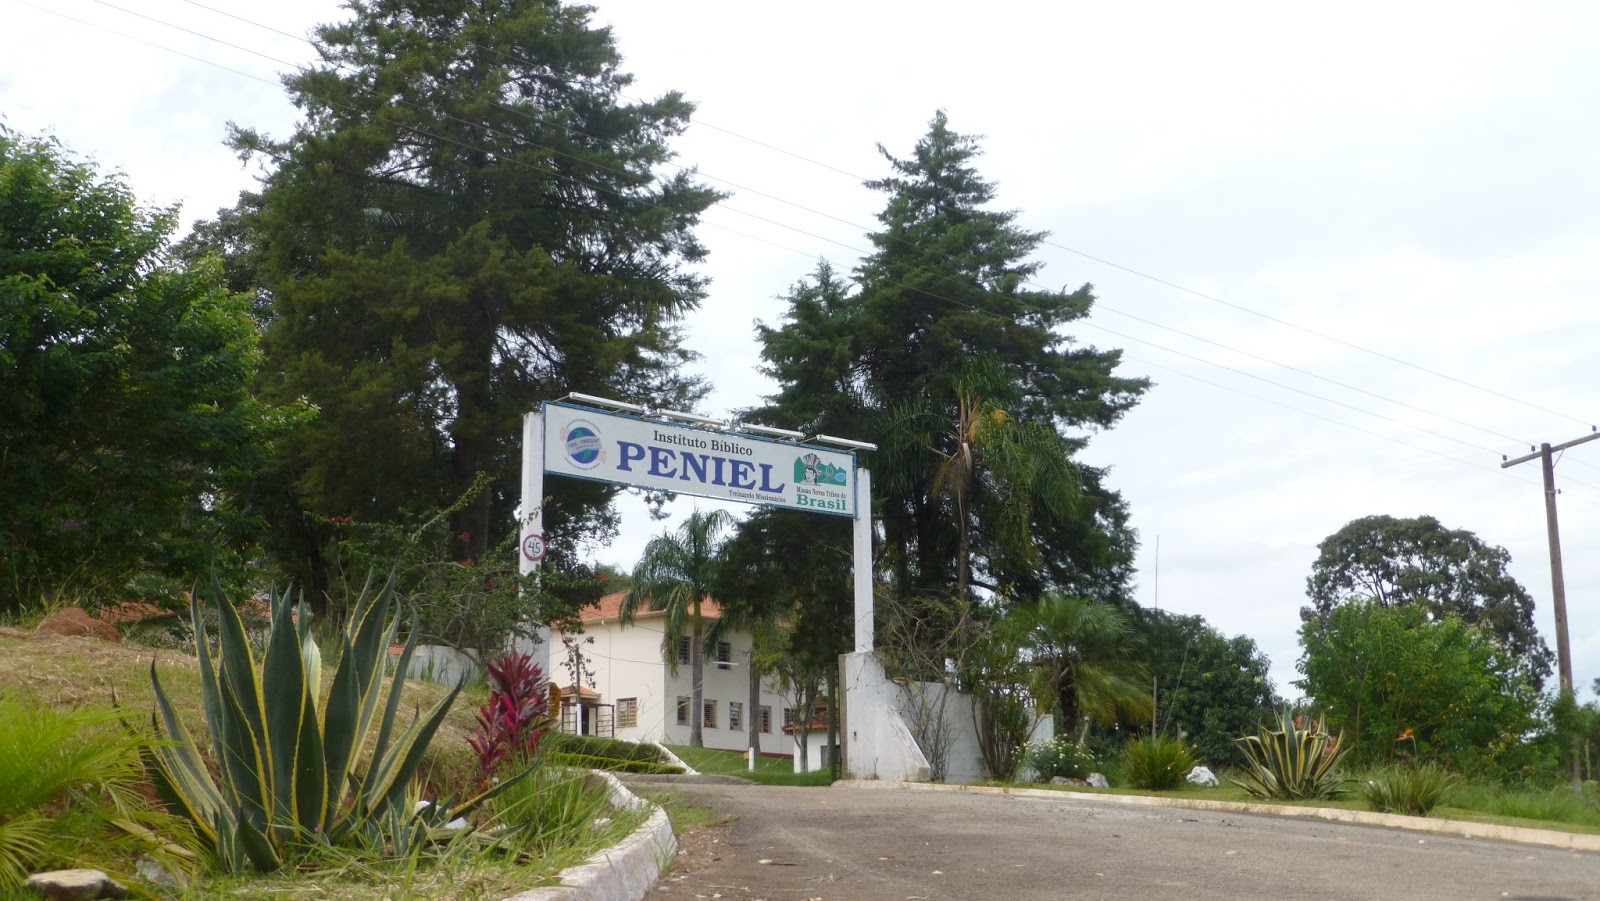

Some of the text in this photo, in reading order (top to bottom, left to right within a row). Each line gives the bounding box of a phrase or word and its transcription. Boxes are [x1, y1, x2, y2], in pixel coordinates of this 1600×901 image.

[653, 430, 753, 456] Instituto Bíblico
[616, 440, 786, 494] PENIEL
[796, 493, 847, 511] Brasil
[528, 541, 541, 554] 45
